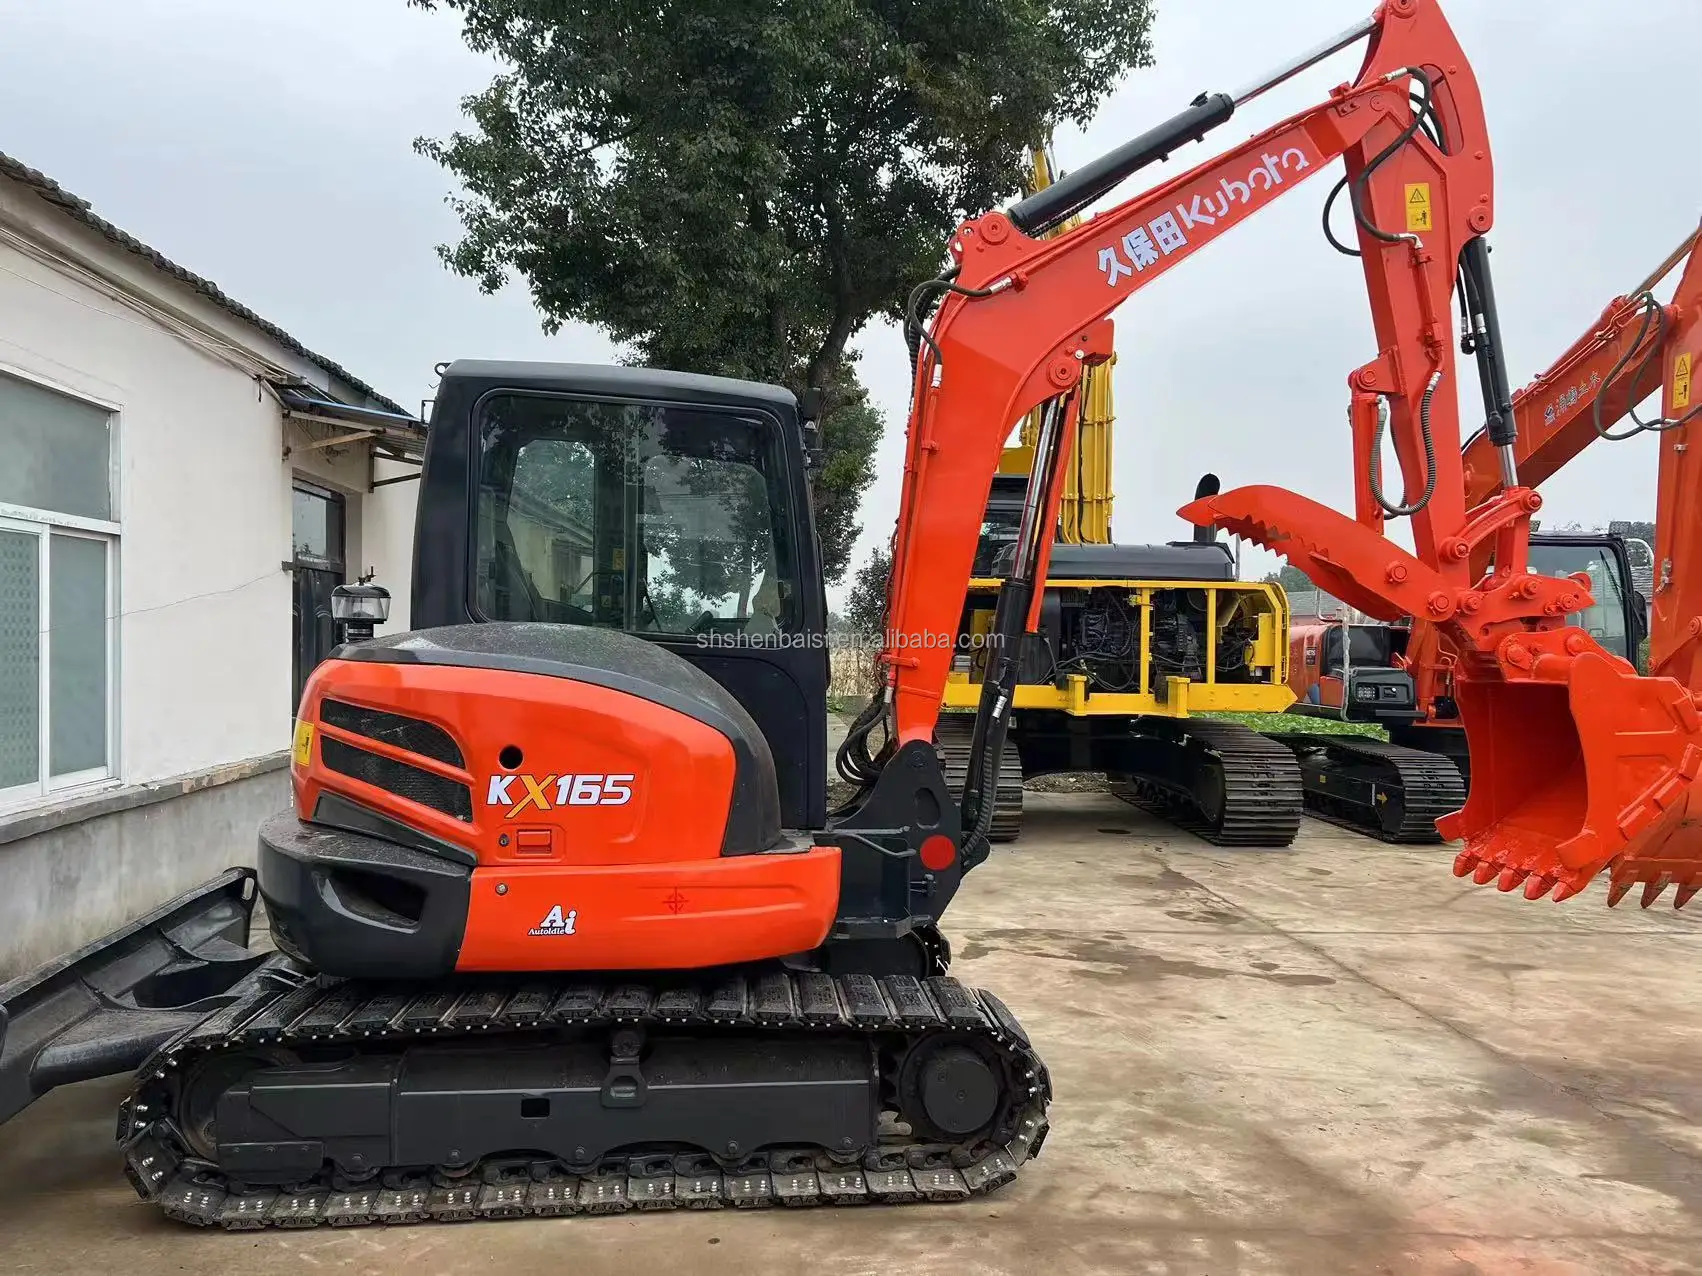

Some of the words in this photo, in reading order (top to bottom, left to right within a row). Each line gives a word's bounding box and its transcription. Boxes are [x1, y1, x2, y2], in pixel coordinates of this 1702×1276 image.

[1176, 148, 1309, 230] Kubota
[1097, 211, 1188, 287] 久保田
[486, 774, 634, 819] KX165
[540, 904, 577, 935] Ai
